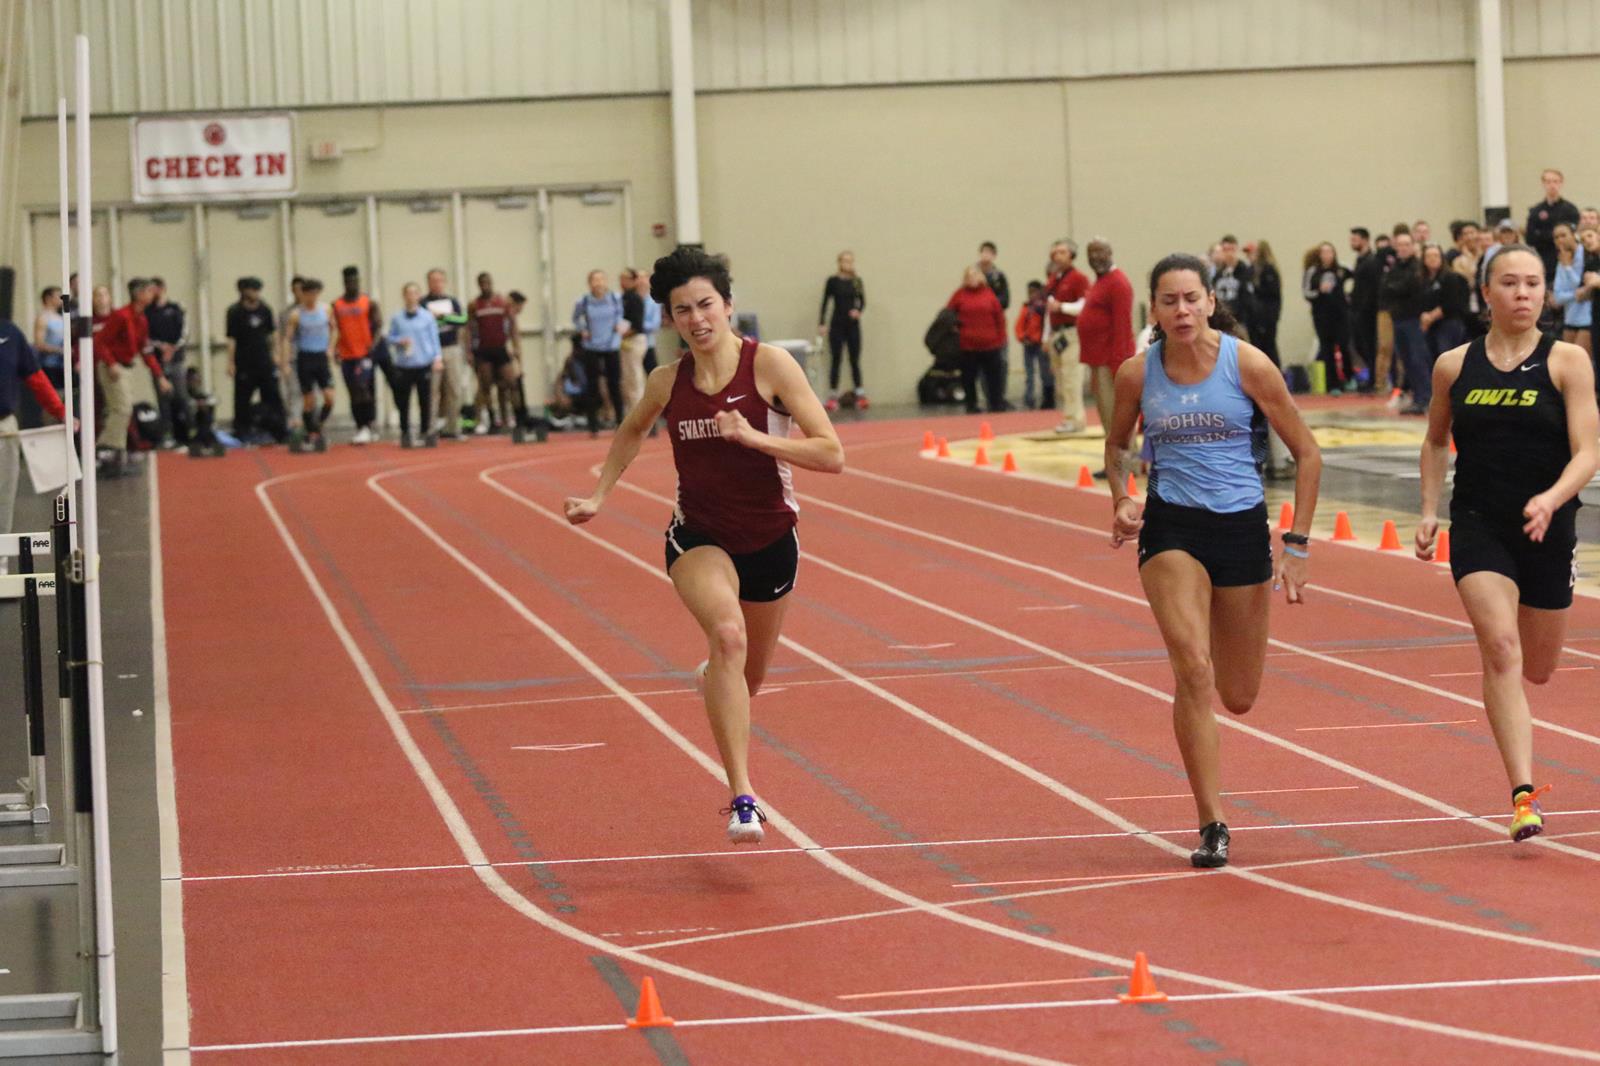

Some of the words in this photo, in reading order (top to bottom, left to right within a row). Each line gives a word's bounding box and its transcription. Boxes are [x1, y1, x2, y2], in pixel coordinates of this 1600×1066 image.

[146, 155, 241, 179] CHECK
[255, 153, 285, 176] IN
[1464, 388, 1539, 406] OWLS
[678, 418, 721, 440] SWARTH
[1159, 411, 1225, 432] JOHNS
